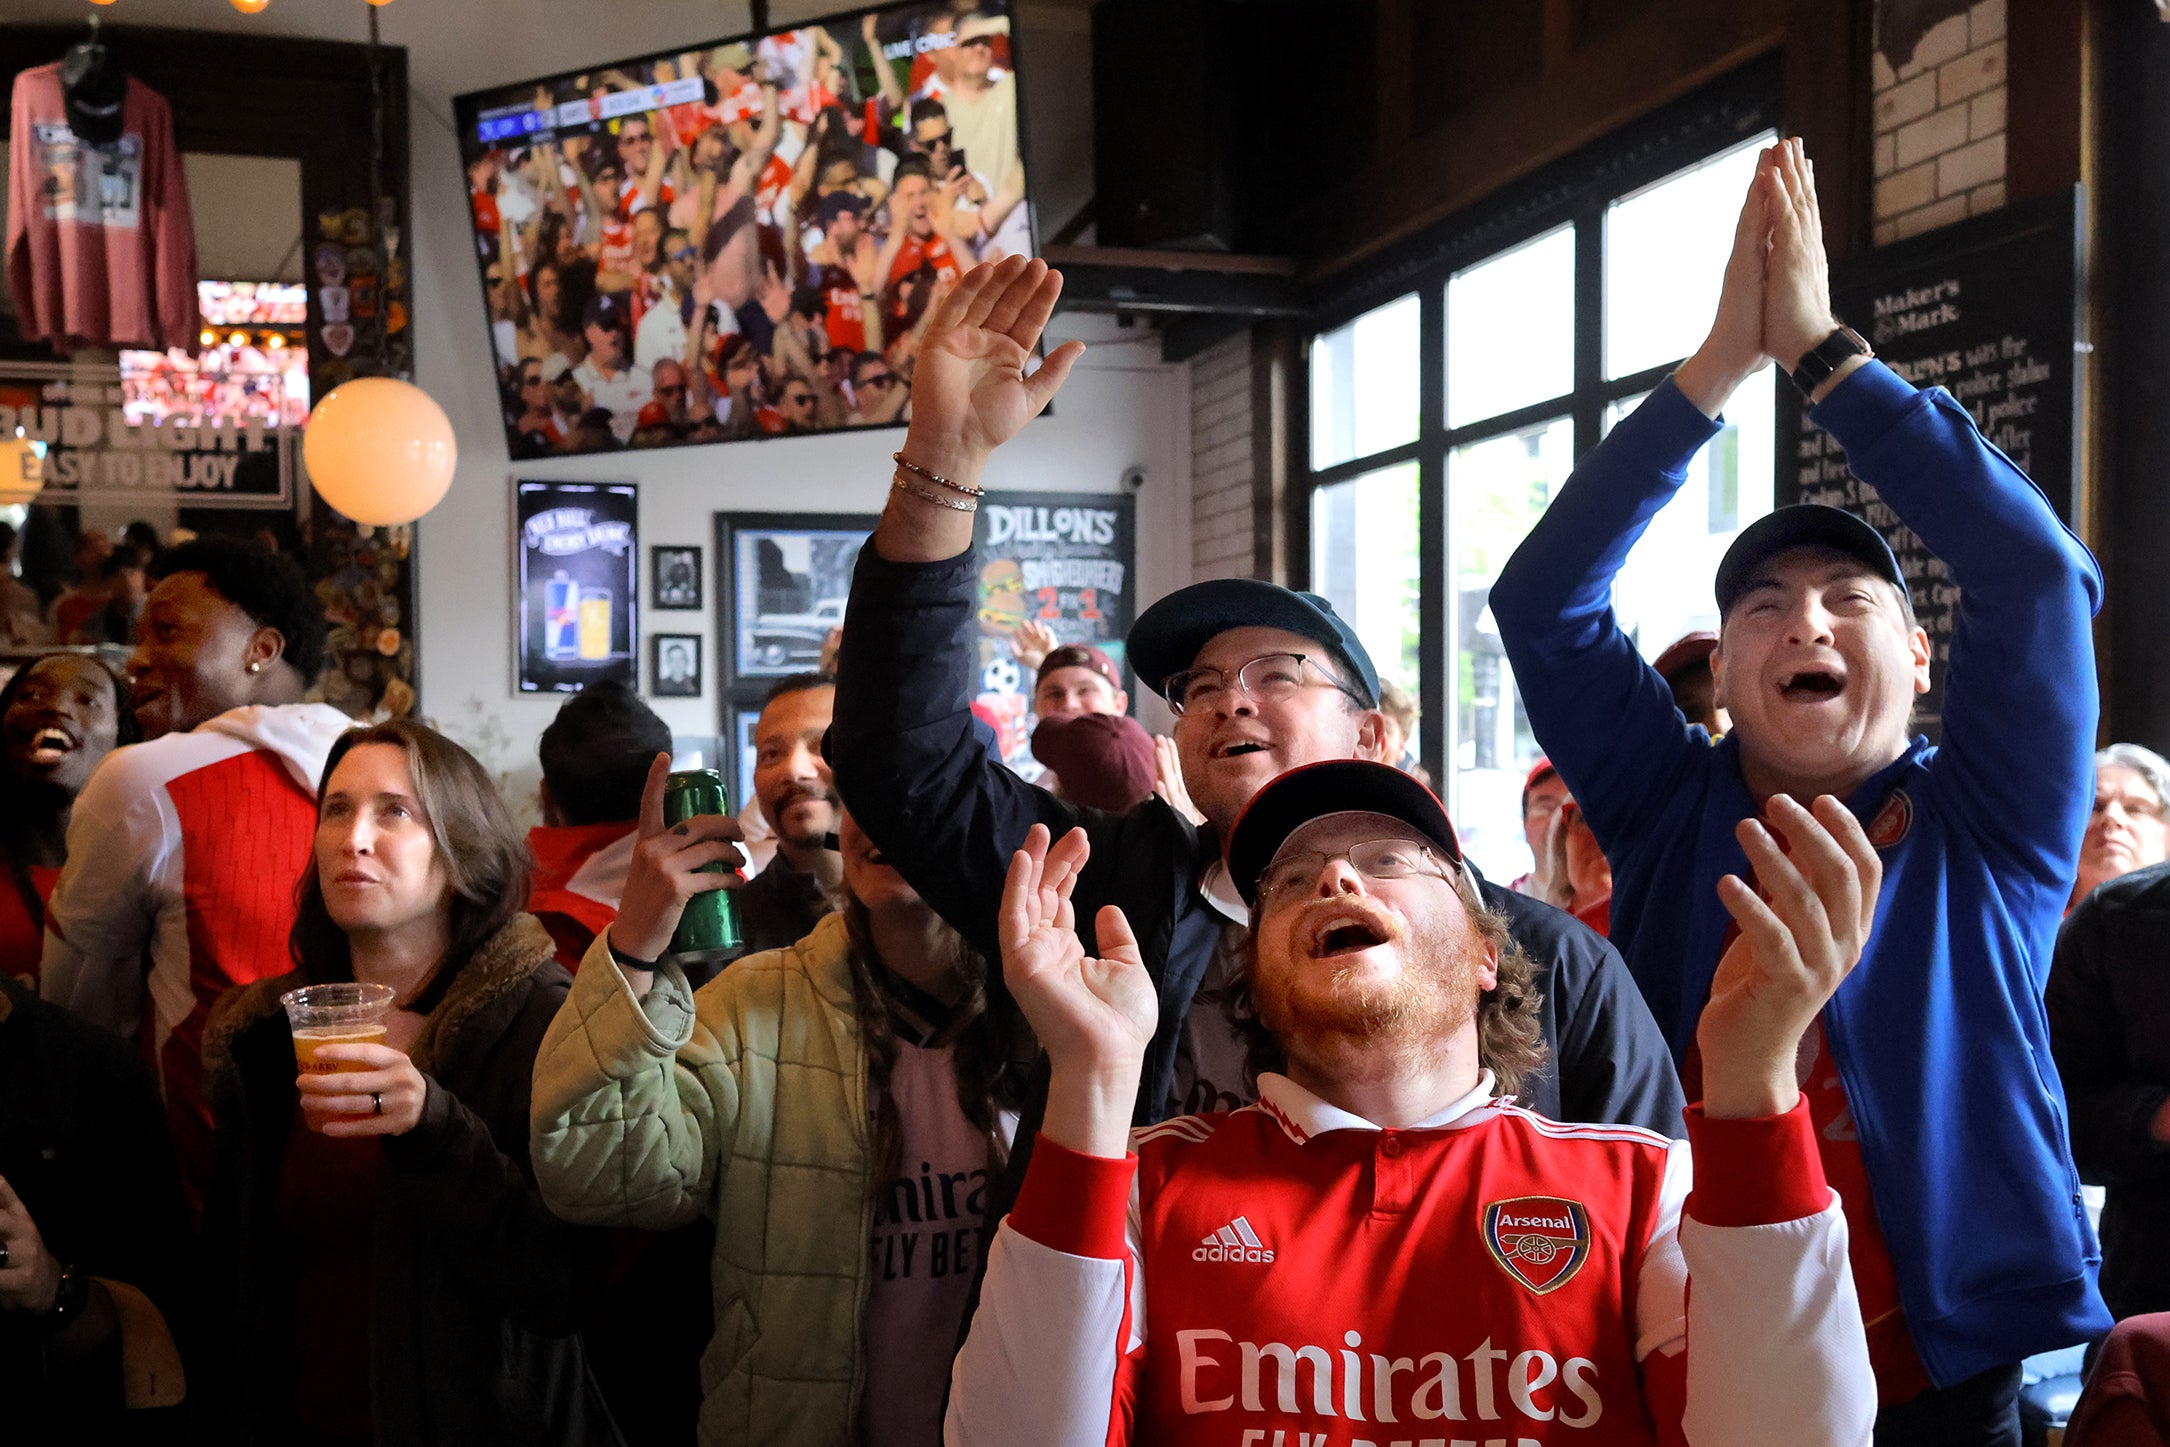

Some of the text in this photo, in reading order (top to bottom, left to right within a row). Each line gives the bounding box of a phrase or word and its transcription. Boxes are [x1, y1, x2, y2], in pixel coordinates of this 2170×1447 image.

[1873, 279, 1960, 317] Maker's
[1898, 303, 1960, 337] Mark
[21, 450, 238, 489] EASY TO ENJOY
[984, 504, 1117, 546] DILLONS
[1038, 586, 1060, 619] 2
[1079, 588, 1102, 619] 1
[1499, 1213, 1571, 1230] Arsenal
[1192, 1243, 1275, 1263] adidas
[1175, 1329, 1603, 1429] Emirates
